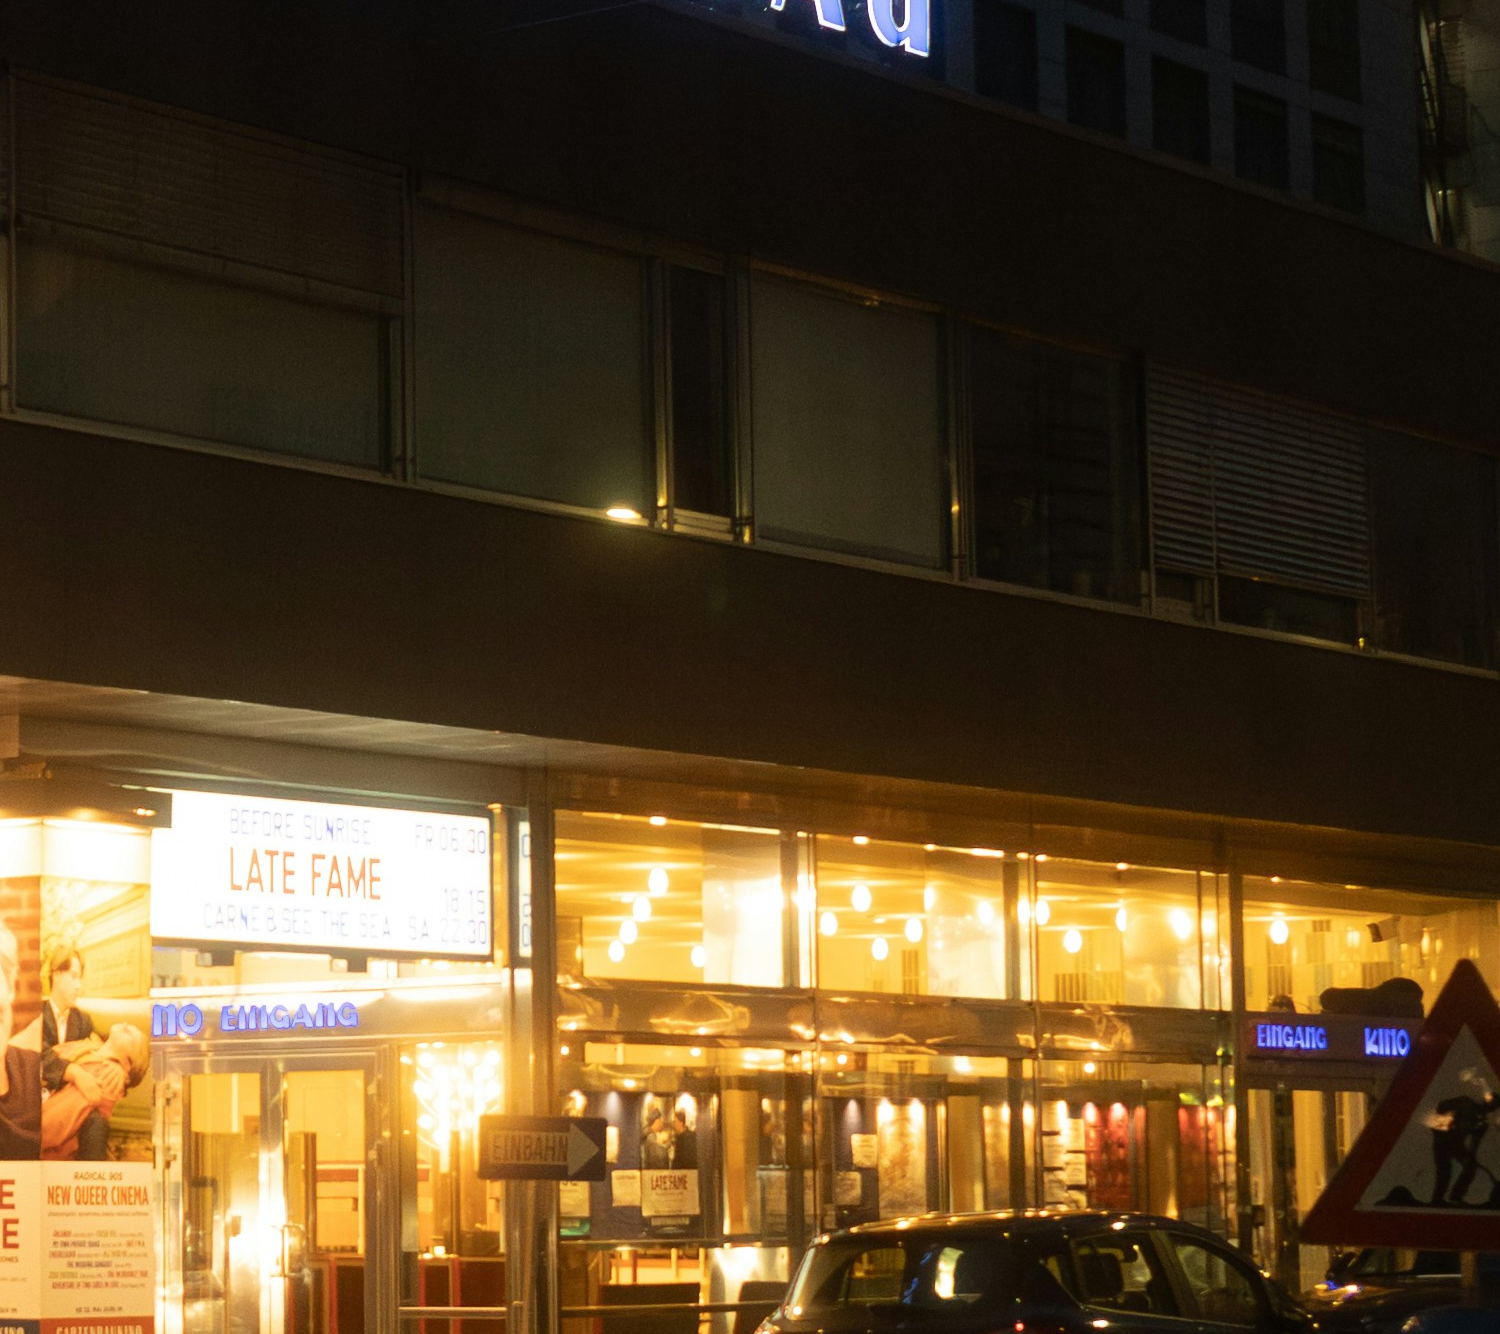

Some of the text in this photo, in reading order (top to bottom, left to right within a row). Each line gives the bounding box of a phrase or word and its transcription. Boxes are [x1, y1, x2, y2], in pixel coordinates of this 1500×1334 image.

[230, 807, 294, 839] BEFORE
[303, 815, 372, 845] SUNRISE
[230, 846, 381, 901] LATE FAME
[203, 903, 260, 932] CARNE
[281, 908, 313, 936] SEE
[320, 909, 350, 938] THE
[358, 911, 393, 939] SEA
[220, 1001, 359, 1033] EINGANG
[1256, 1023, 1328, 1050] EINGANG
[1364, 1026, 1411, 1058] KINO
[491, 1132, 569, 1163] EINBAHN
[73, 1171, 107, 1181] RADICAL
[47, 1185, 149, 1206] NEW QUEER CINEMA
